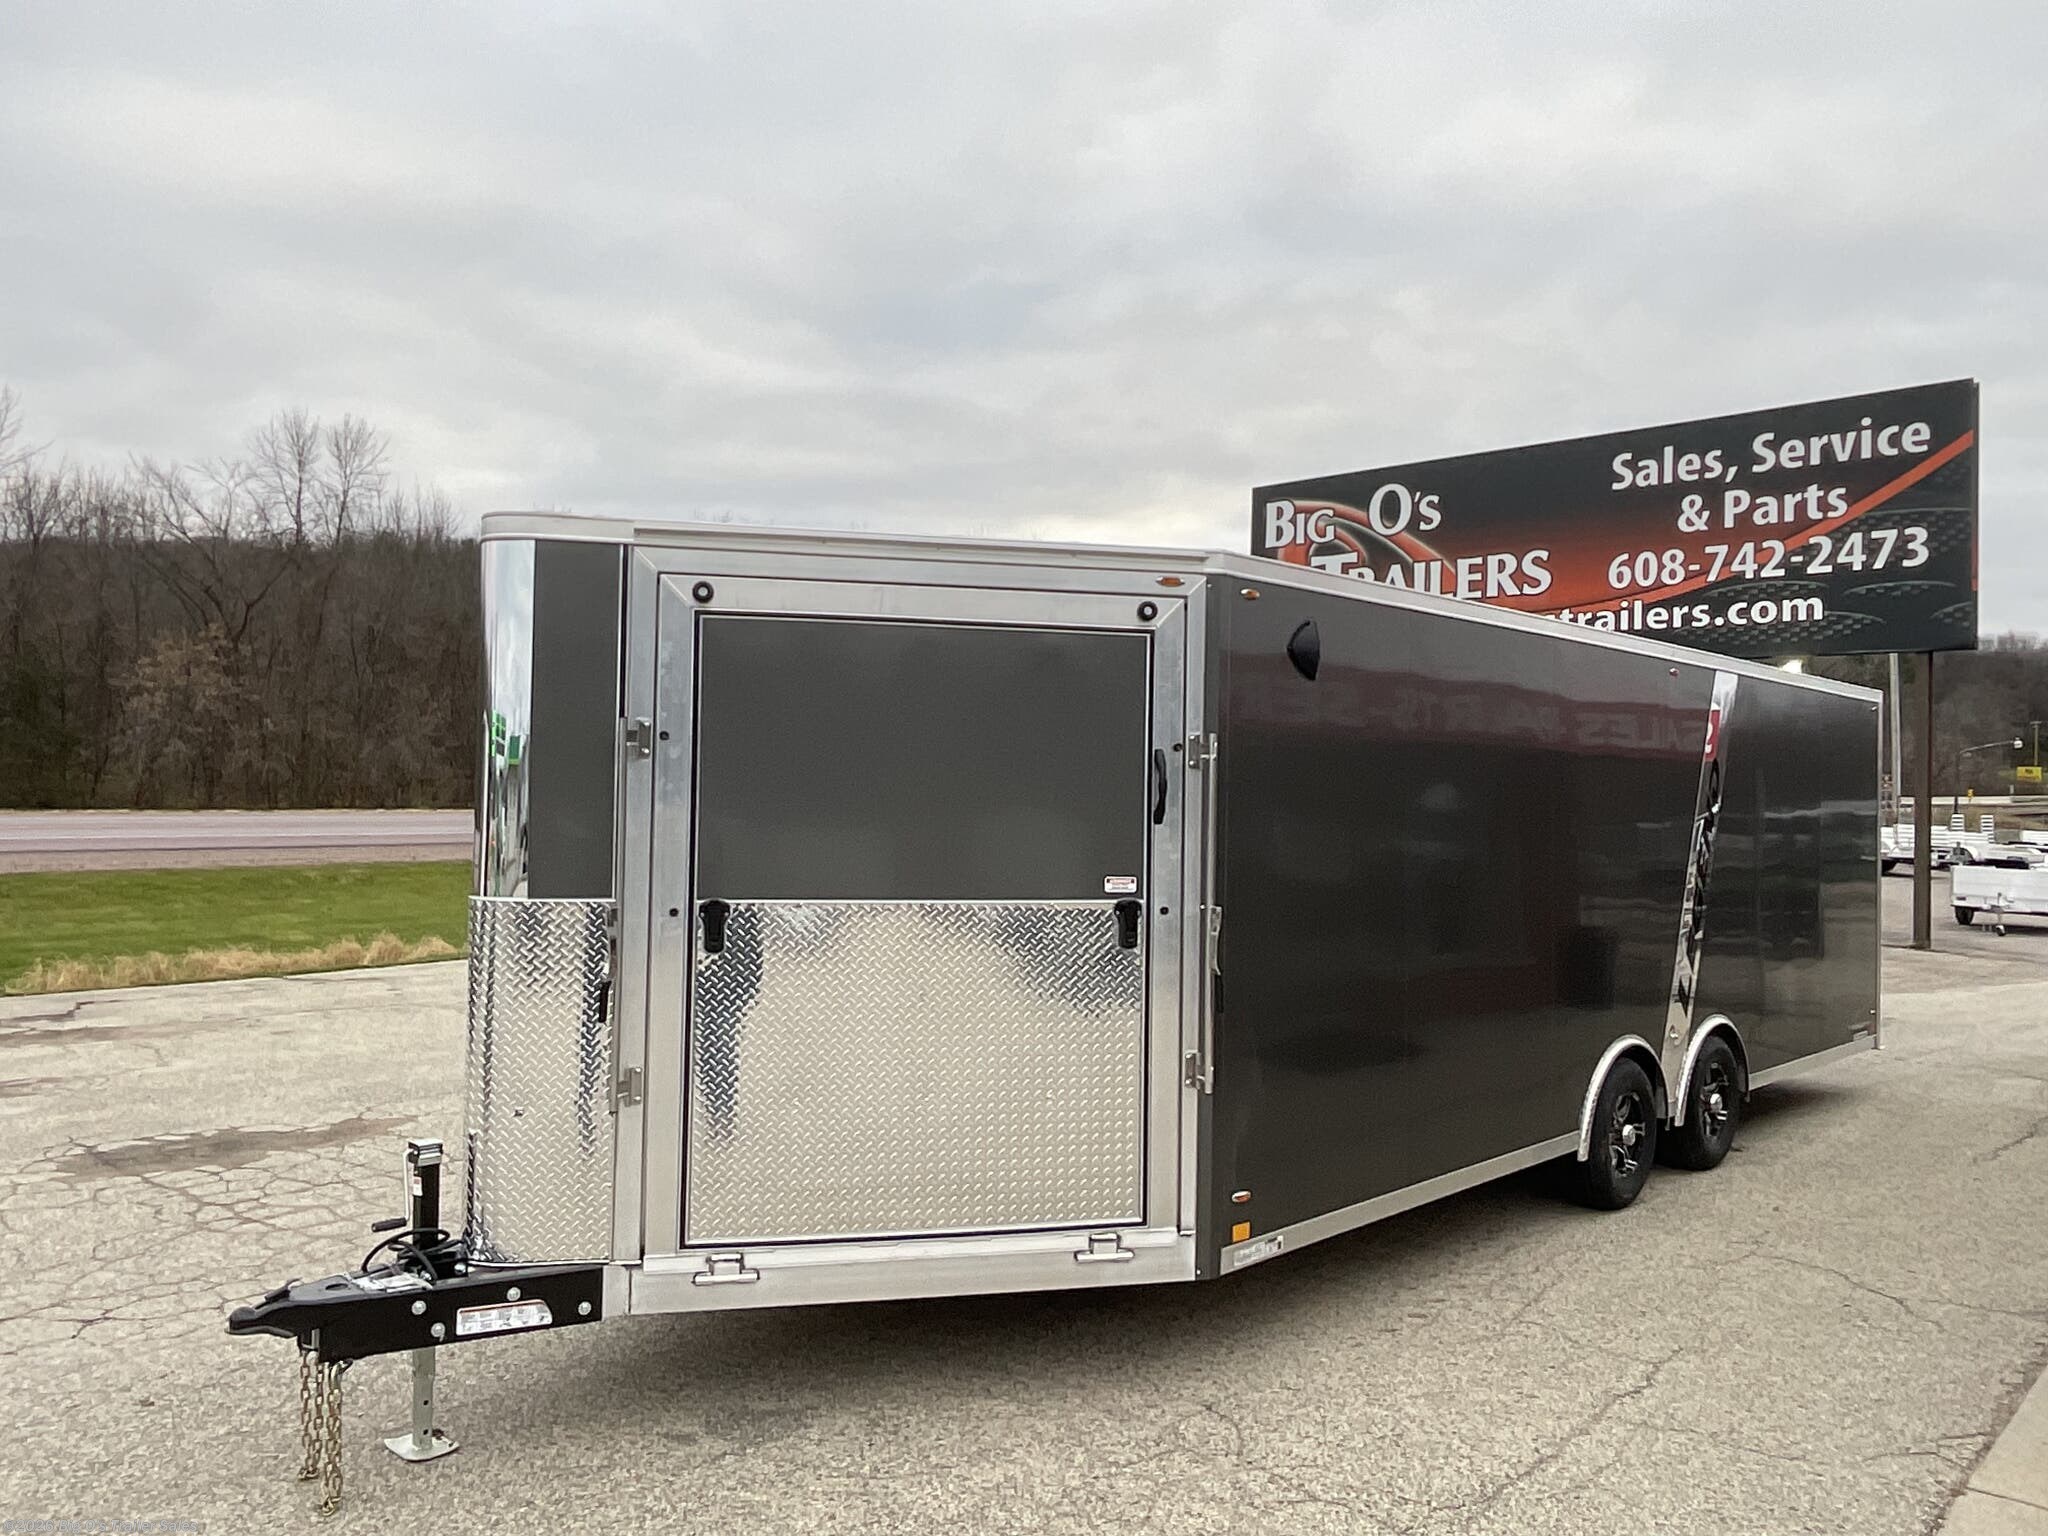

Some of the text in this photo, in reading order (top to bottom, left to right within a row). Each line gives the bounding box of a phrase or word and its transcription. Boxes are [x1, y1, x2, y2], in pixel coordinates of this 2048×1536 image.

[1611, 416, 1932, 491] Sales, Service
[1676, 483, 1849, 534] & Parts
[1607, 526, 1930, 589] 608-742-2473
